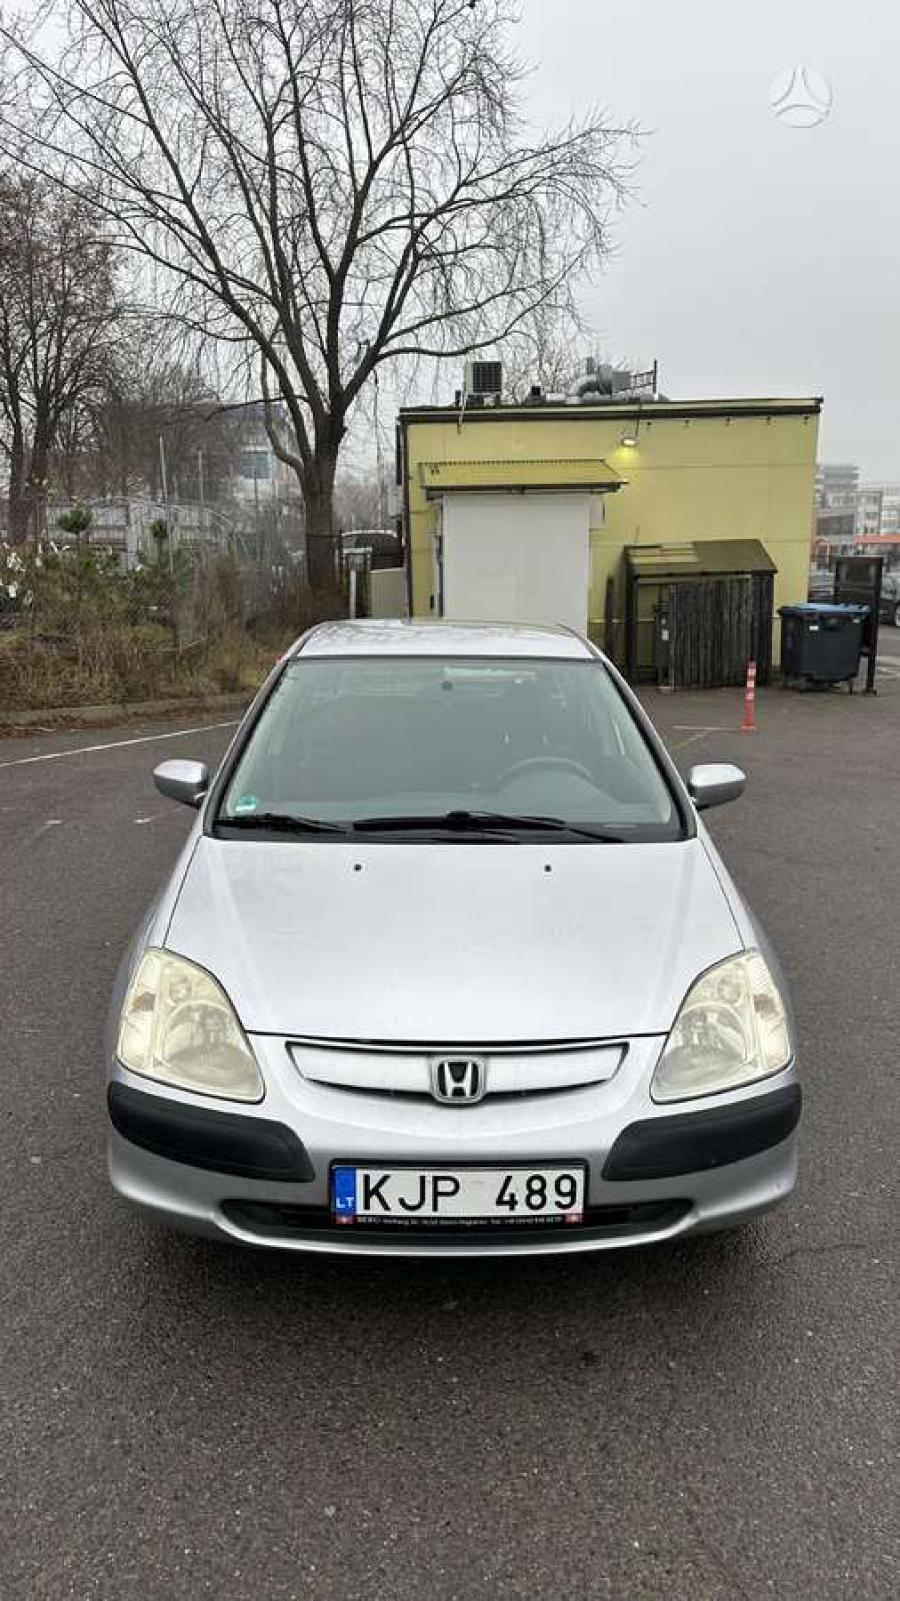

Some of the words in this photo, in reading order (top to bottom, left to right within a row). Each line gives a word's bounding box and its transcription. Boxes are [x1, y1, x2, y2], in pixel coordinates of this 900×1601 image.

[335, 1196, 354, 1209] LT
[362, 1174, 460, 1212] KJP
[495, 1174, 577, 1211] 489
